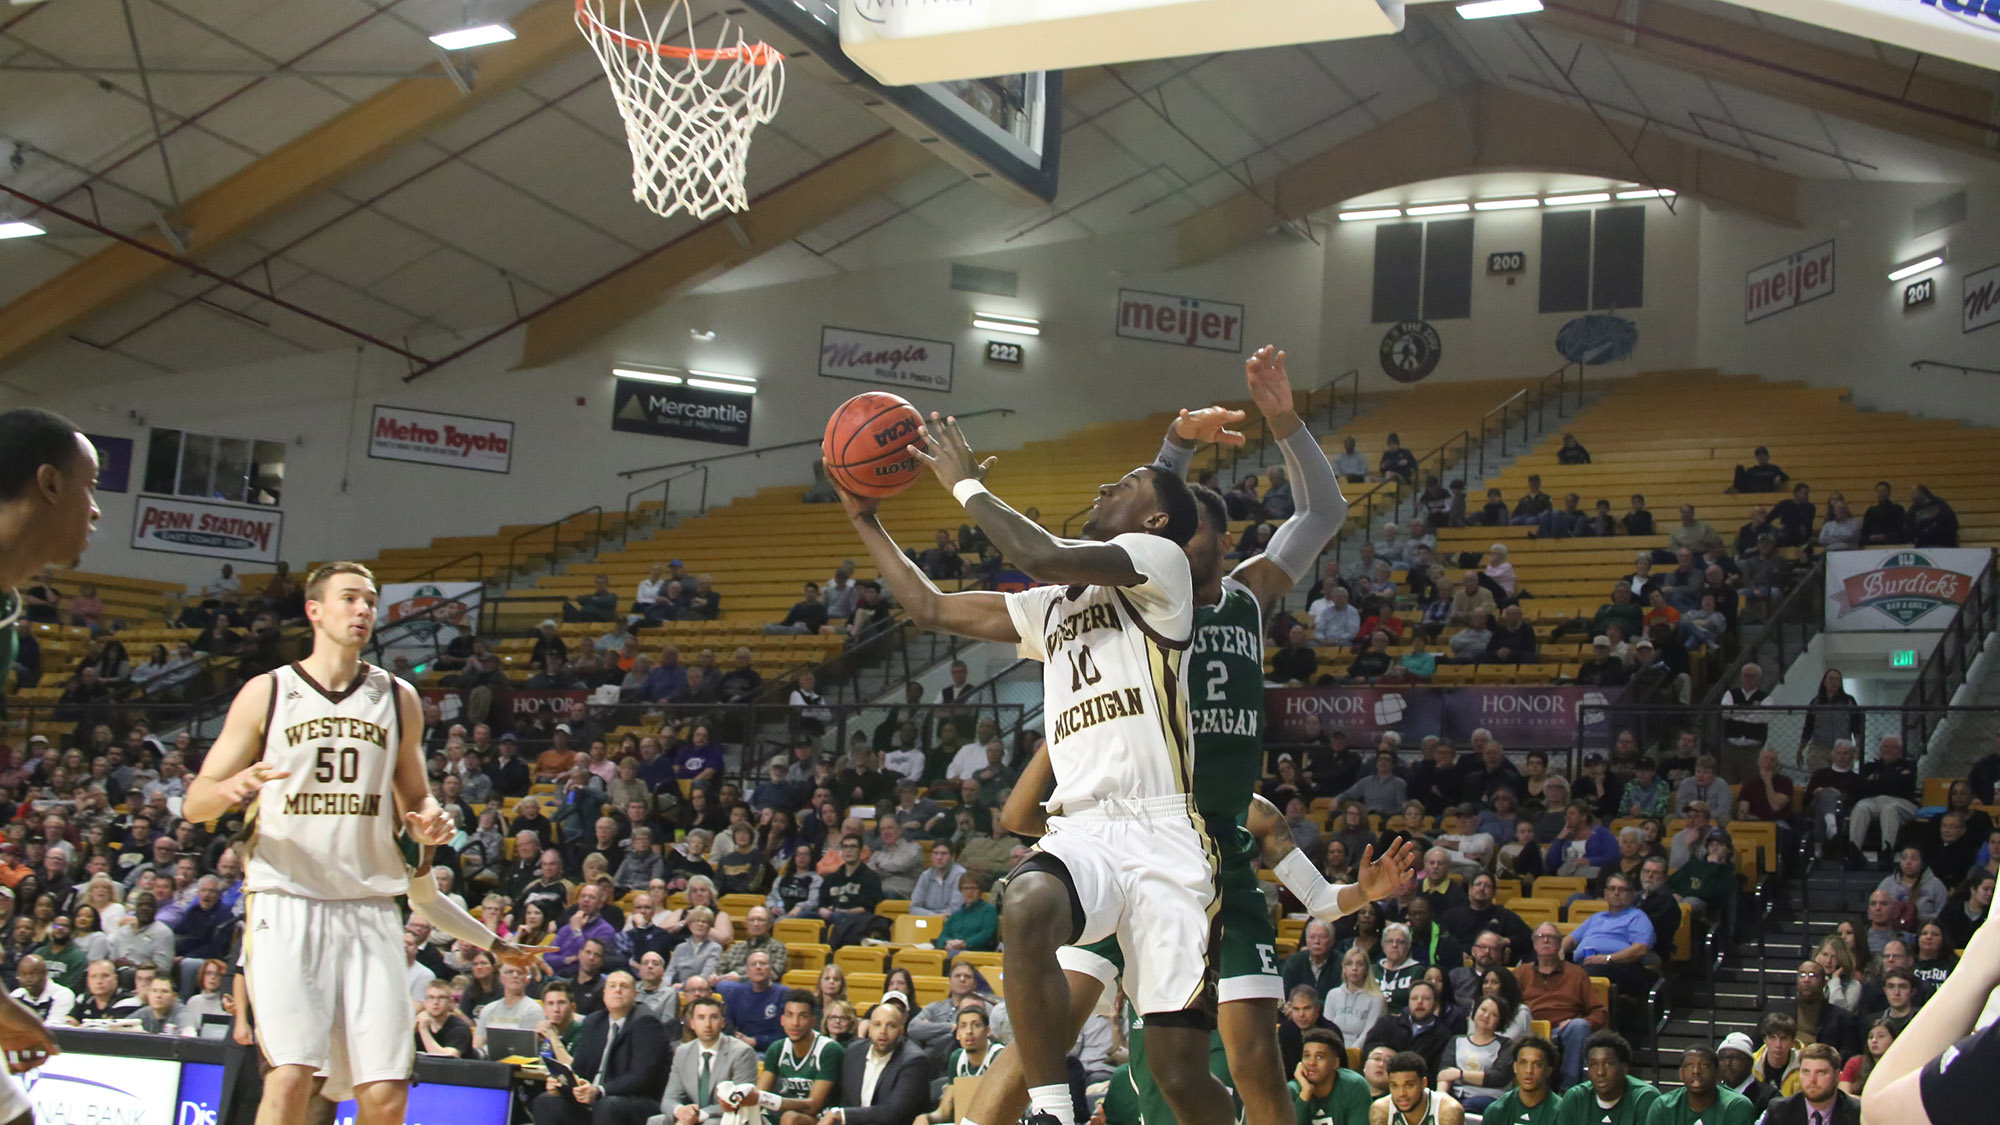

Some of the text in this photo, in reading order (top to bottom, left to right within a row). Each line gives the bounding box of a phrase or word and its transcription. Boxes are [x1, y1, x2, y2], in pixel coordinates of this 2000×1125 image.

[1492, 254, 1521, 270] 200
[1749, 253, 1830, 306] meijer
[1908, 282, 1931, 304] 201
[1121, 297, 1238, 345] meijer
[822, 341, 928, 370] Mangia
[990, 344, 1019, 361] 222
[649, 394, 748, 423] Mercantile
[376, 417, 439, 444] Metro
[444, 425, 508, 457] Toyota
[873, 416, 918, 447] NCAA
[138, 506, 273, 552] PENN STATION
[1898, 554, 1915, 565] OLD
[1860, 570, 1959, 599] Burdick's
[1194, 625, 1258, 665] STERN
[1893, 650, 1914, 666] EXIT
[1068, 644, 1102, 693] 10
[1206, 660, 1229, 701] 2
[513, 697, 574, 714] HOOR
[1054, 687, 1144, 745] MICHIGAN
[1286, 696, 1367, 715] HONOR
[1482, 695, 1565, 713] HONOR
[285, 717, 388, 750] WESTERN
[1191, 708, 1258, 737] CHIGAN
[315, 747, 359, 783] 50
[283, 793, 382, 816] MICHIGAN
[1256, 943, 1278, 974] E
[179, 1101, 217, 1125] Dis
